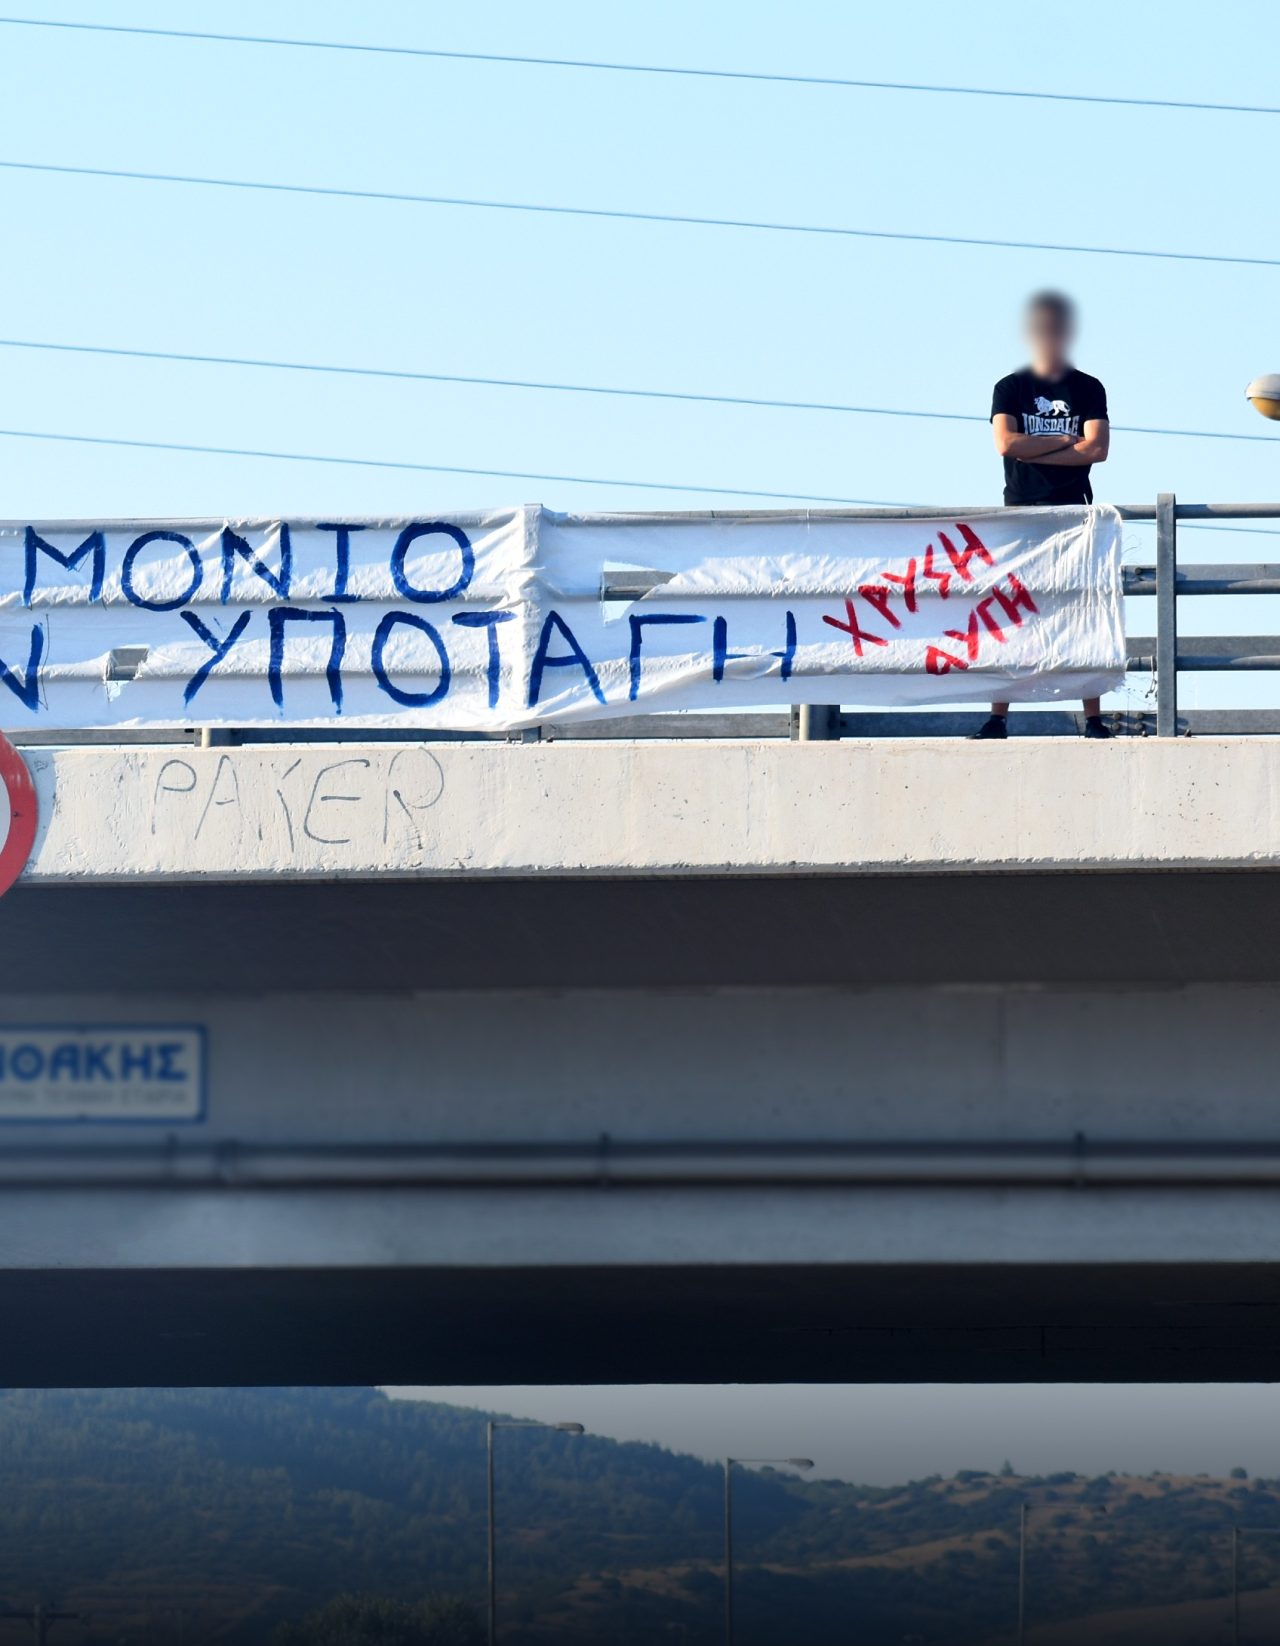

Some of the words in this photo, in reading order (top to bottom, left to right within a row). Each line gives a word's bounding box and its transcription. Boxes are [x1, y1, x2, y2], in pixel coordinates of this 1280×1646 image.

[822, 523, 997, 656] ΧΡΥΣΗ
[925, 572, 1039, 675] ΑΥΓΗ
[179, 607, 797, 716] ΥΠΟΤΑΓΗ
